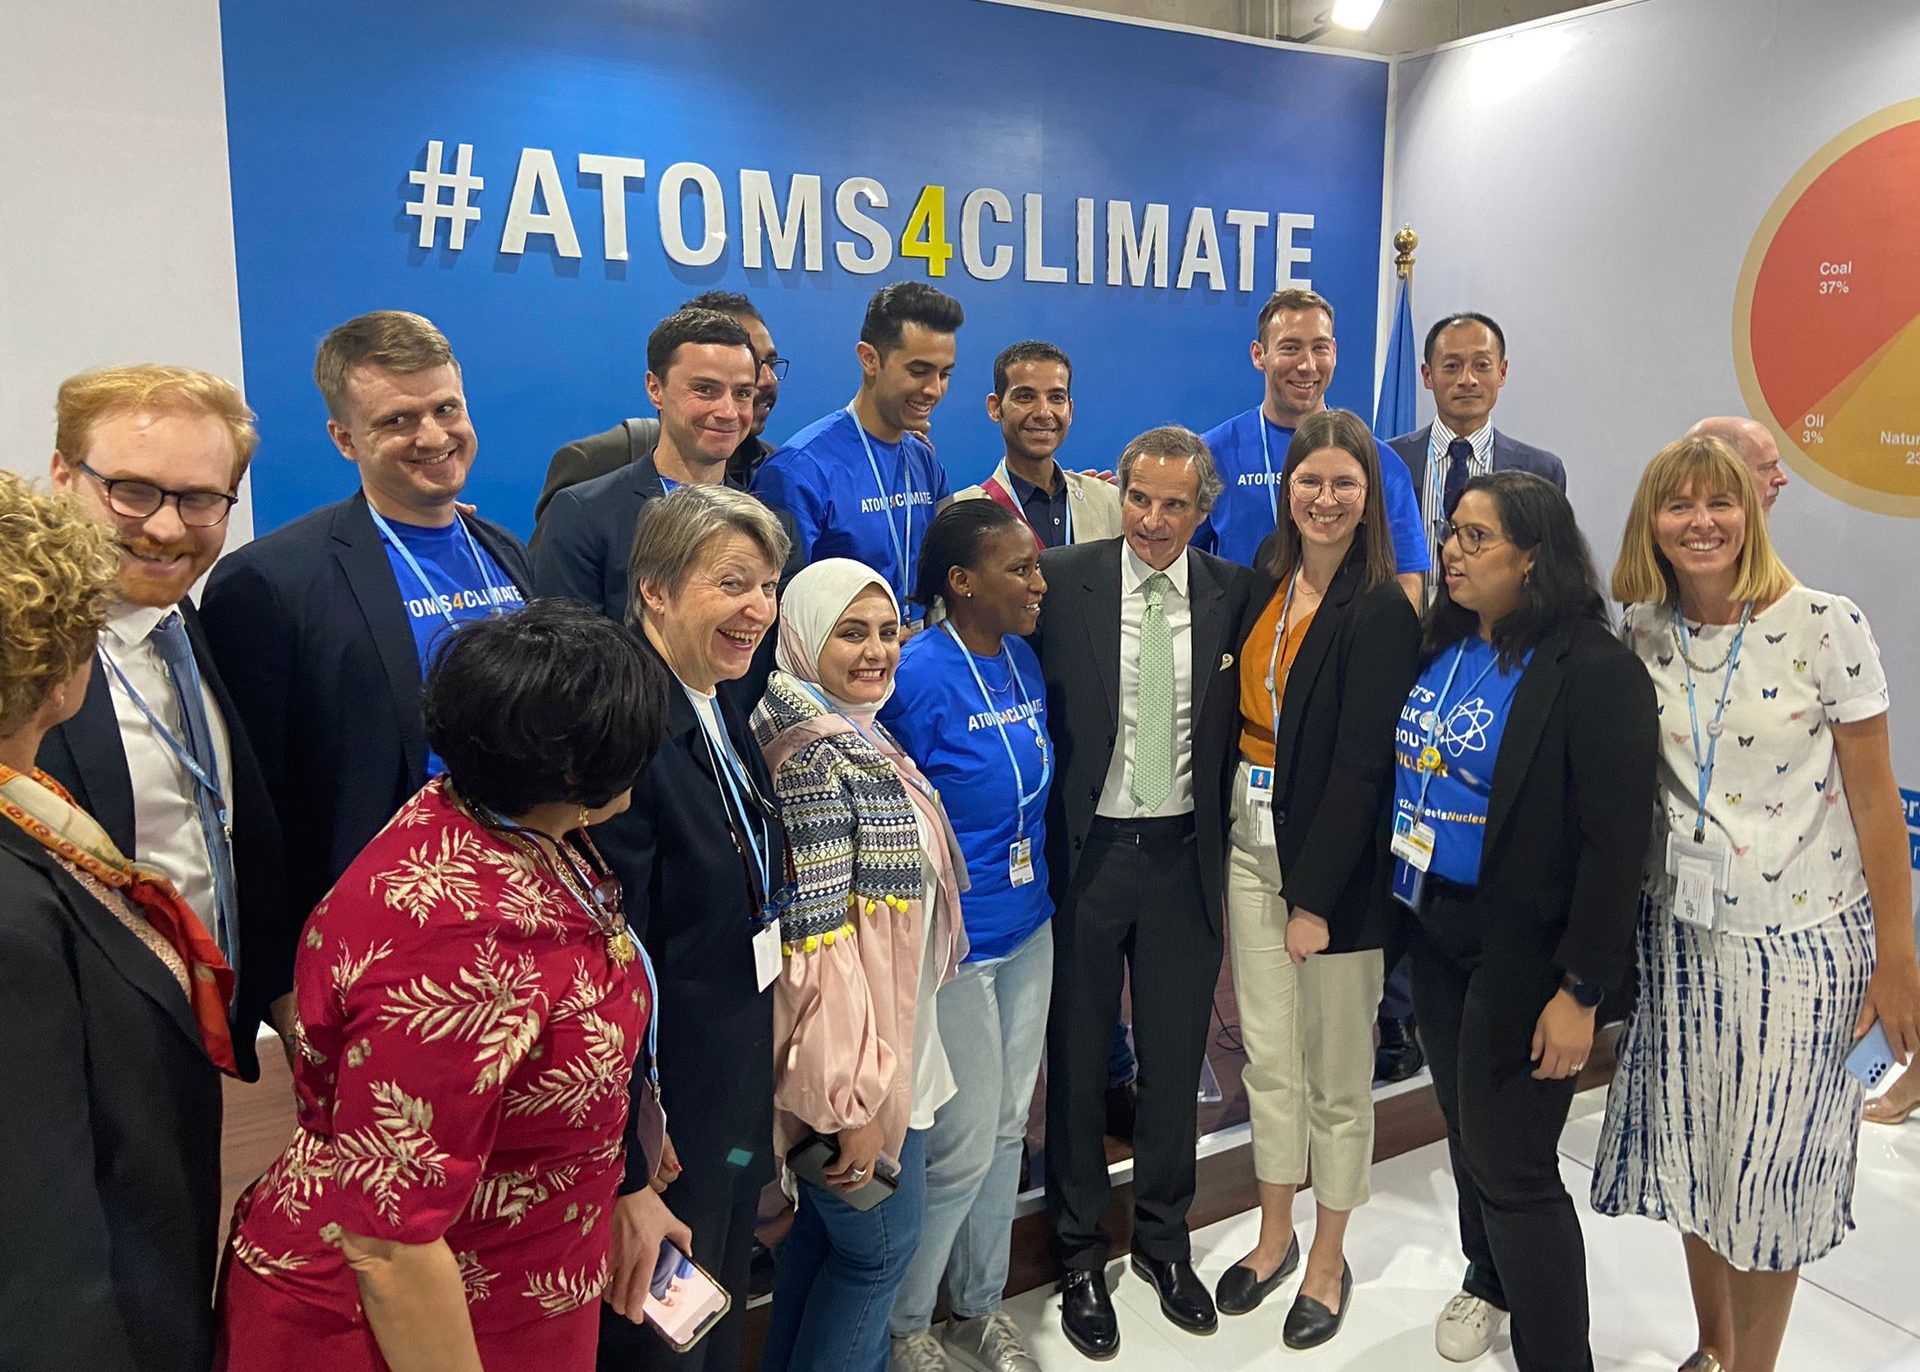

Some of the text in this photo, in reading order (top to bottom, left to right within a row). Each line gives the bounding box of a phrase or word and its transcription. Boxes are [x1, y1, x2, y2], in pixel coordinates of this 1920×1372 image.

[405, 140, 1315, 292] #ATOMS4CLIMATE
[1819, 260, 1852, 275] Coal
[1819, 280, 1849, 294] 37%
[1805, 413, 1824, 428] Oil
[1803, 430, 1824, 443] 3%
[404, 585, 524, 618] OMS4CLIMATE
